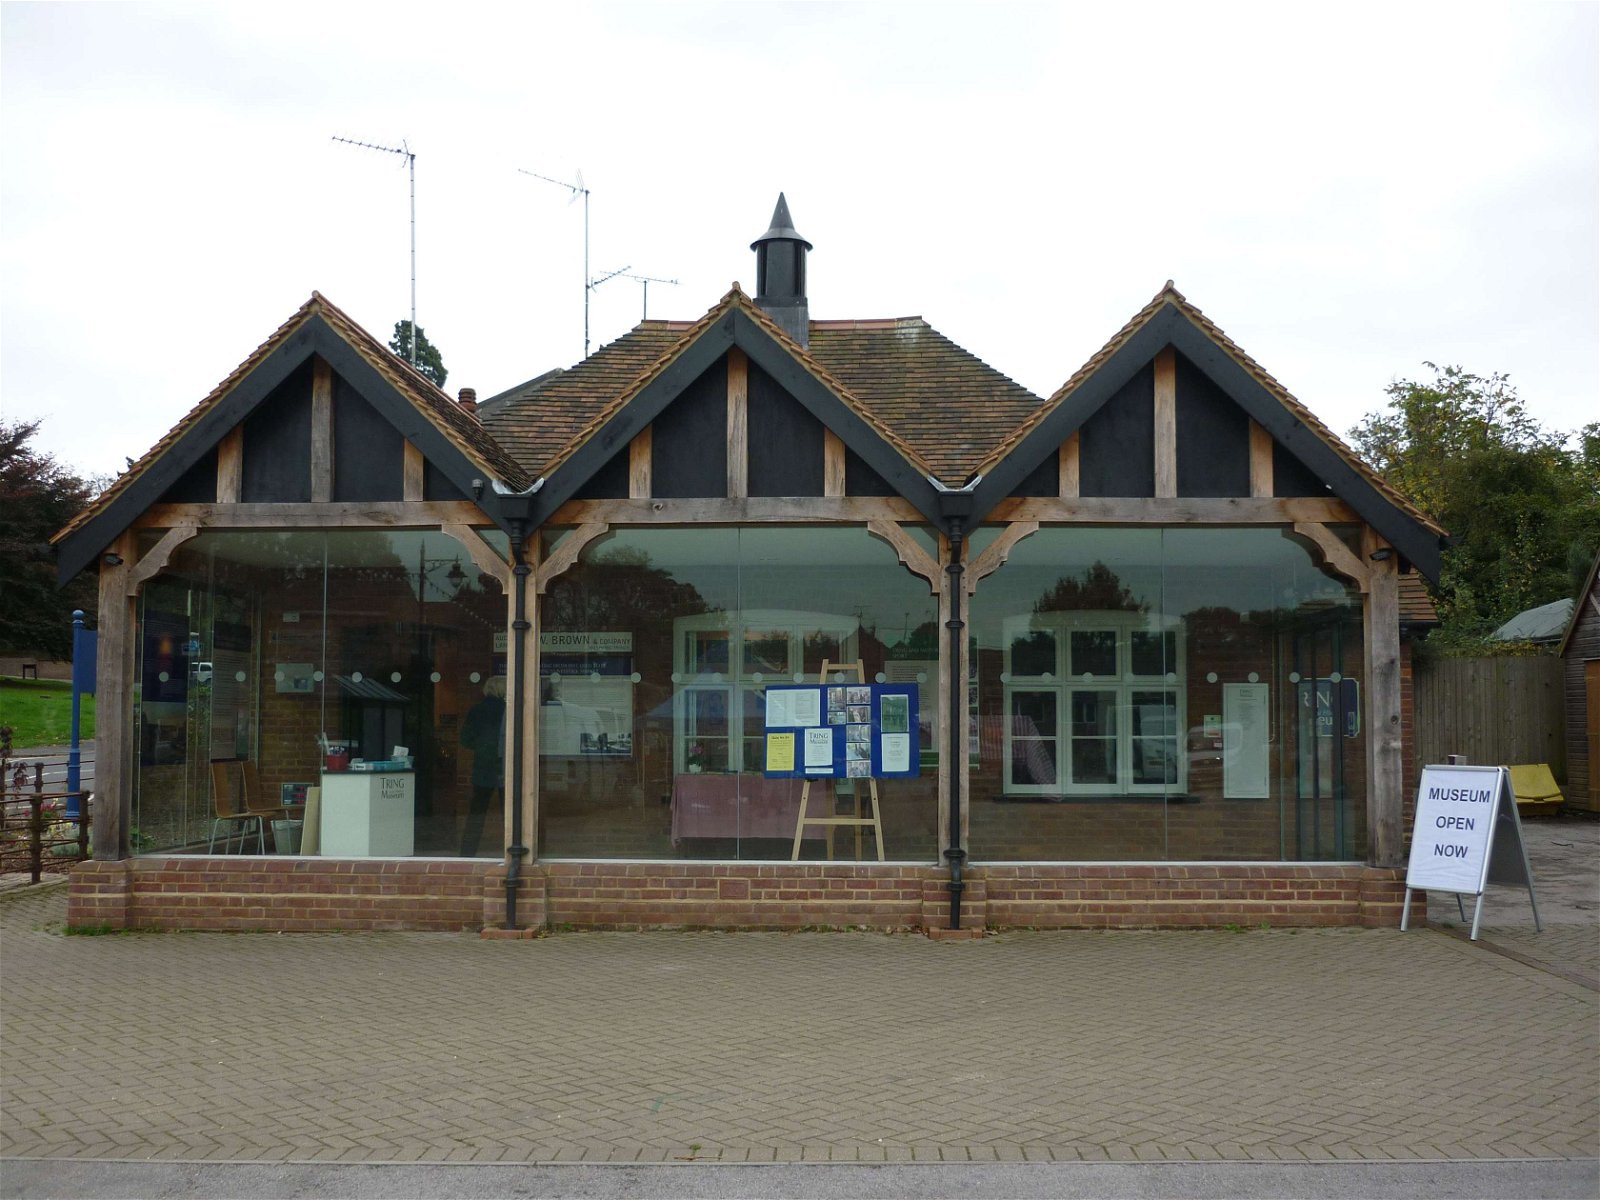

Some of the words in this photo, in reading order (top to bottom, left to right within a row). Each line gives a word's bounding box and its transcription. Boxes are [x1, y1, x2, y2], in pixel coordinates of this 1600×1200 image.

[551, 635, 590, 645] BROWN
[380, 777, 405, 789] TRING
[1428, 787, 1491, 803] MUSEUM
[1435, 815, 1475, 831] OPEN
[1433, 843, 1469, 859] NOW
